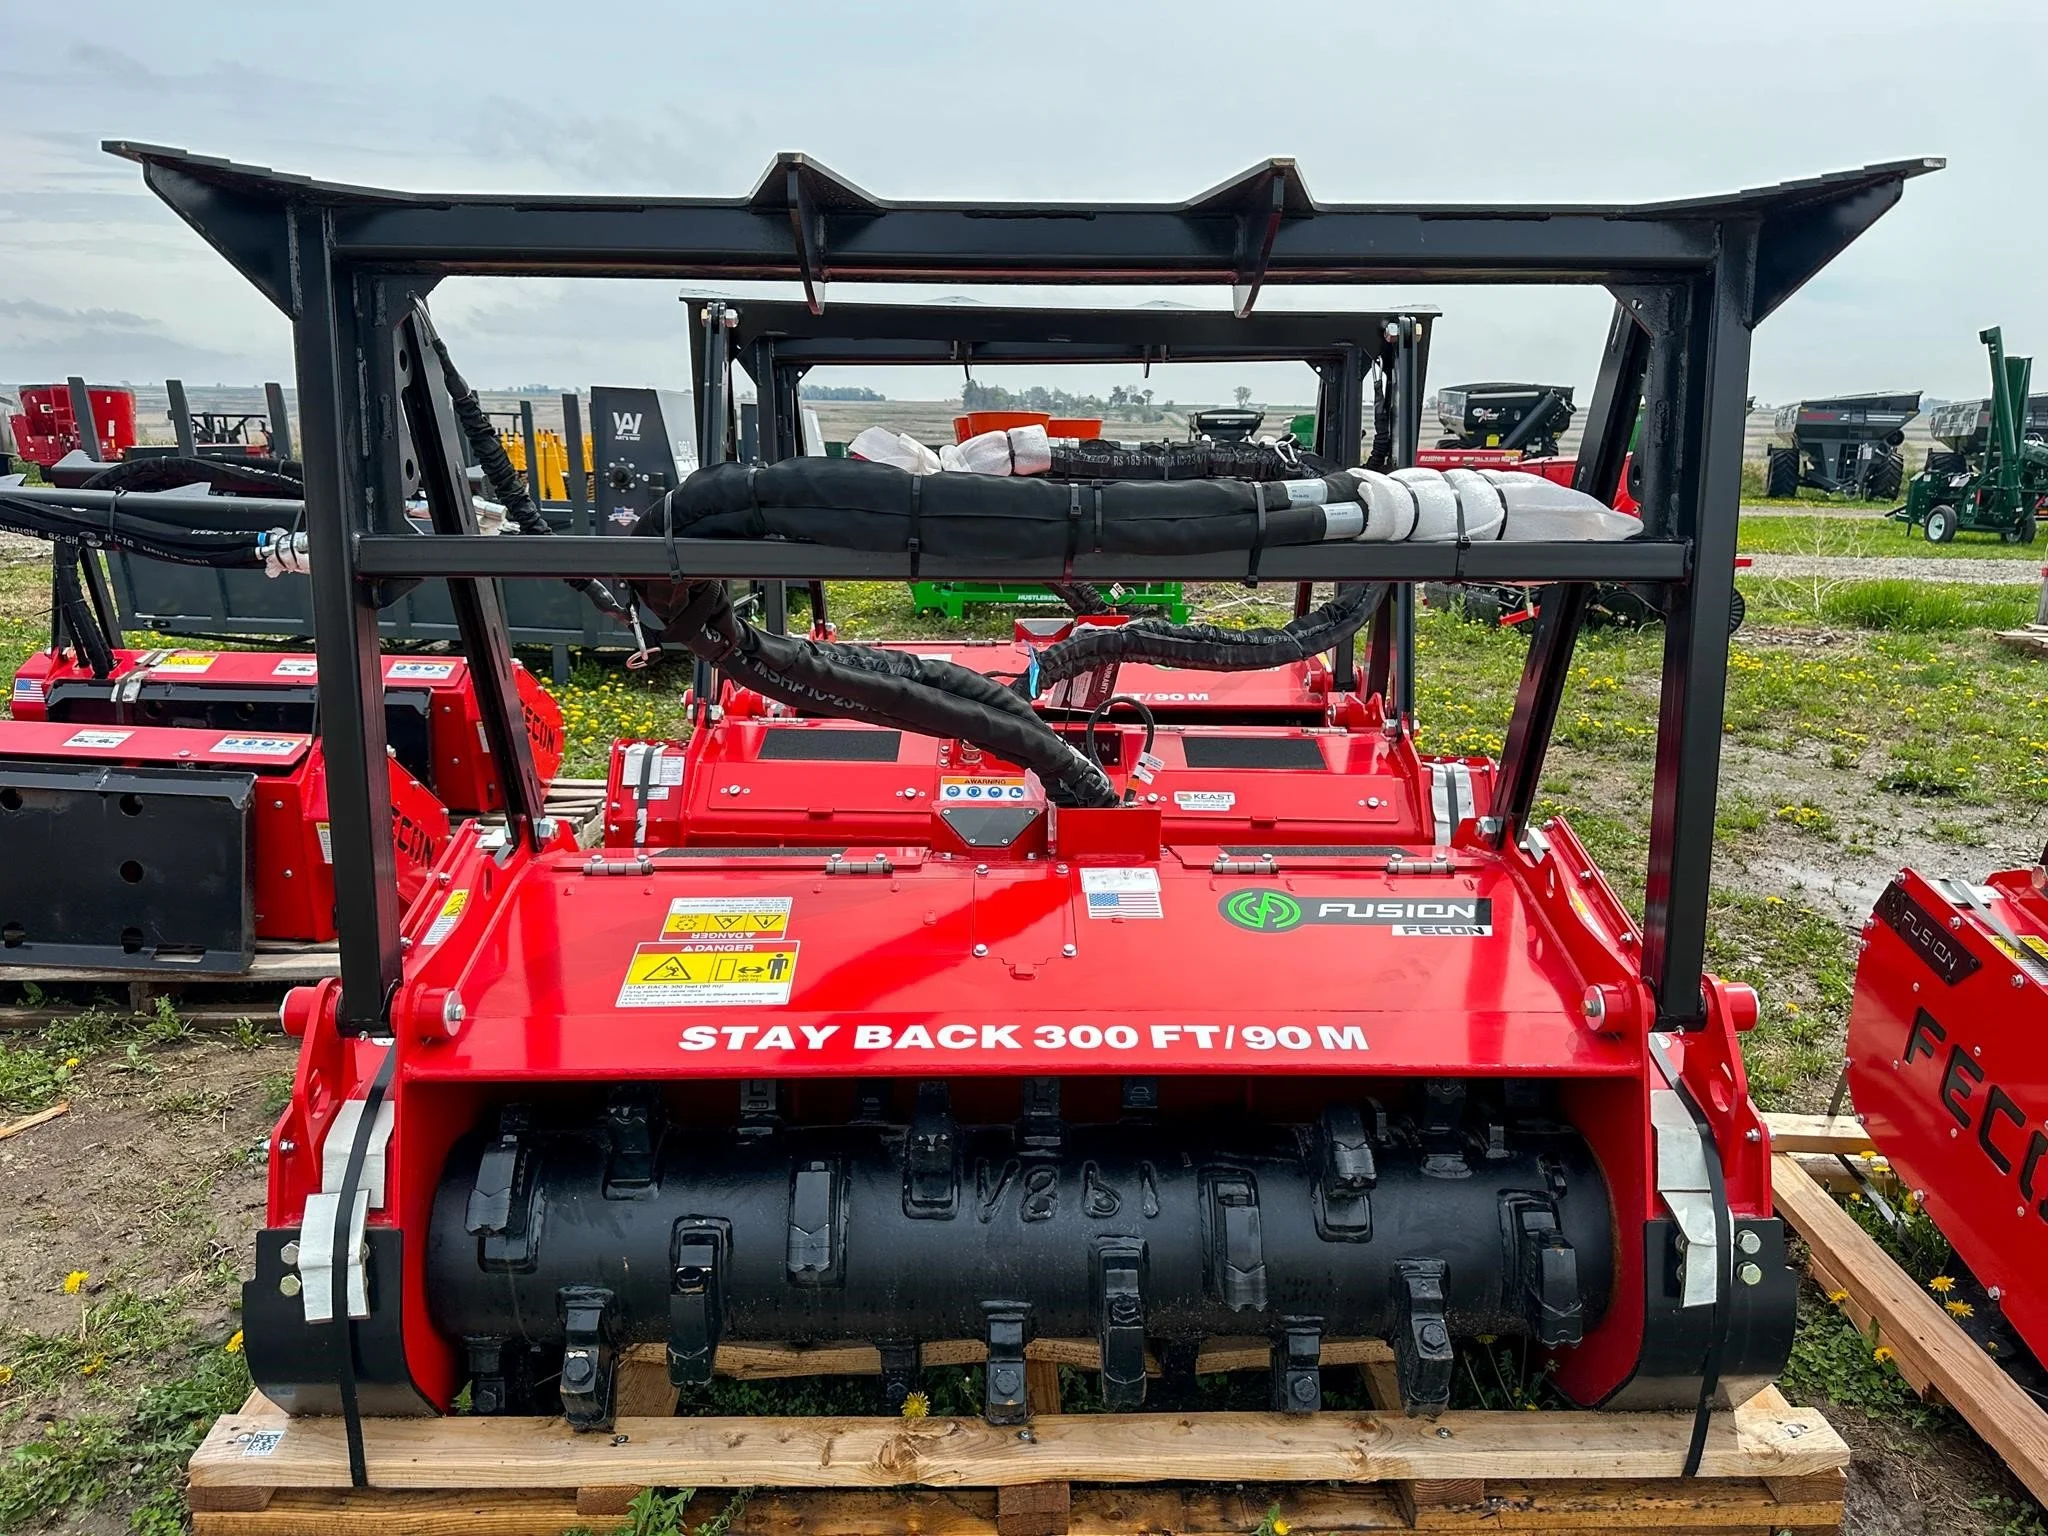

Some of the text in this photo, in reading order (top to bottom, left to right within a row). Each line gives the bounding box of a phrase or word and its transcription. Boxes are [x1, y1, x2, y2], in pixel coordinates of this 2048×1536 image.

[1188, 692, 1209, 702] M
[520, 699, 556, 755] ECON
[1318, 903, 1476, 919] FUSION
[691, 932, 745, 940] DANGER
[1402, 925, 1485, 935] FECON
[1901, 909, 1958, 972] FUSION
[694, 944, 754, 952] DANGER
[678, 1025, 1370, 1050] STAY BACK 300 FT/90 M
